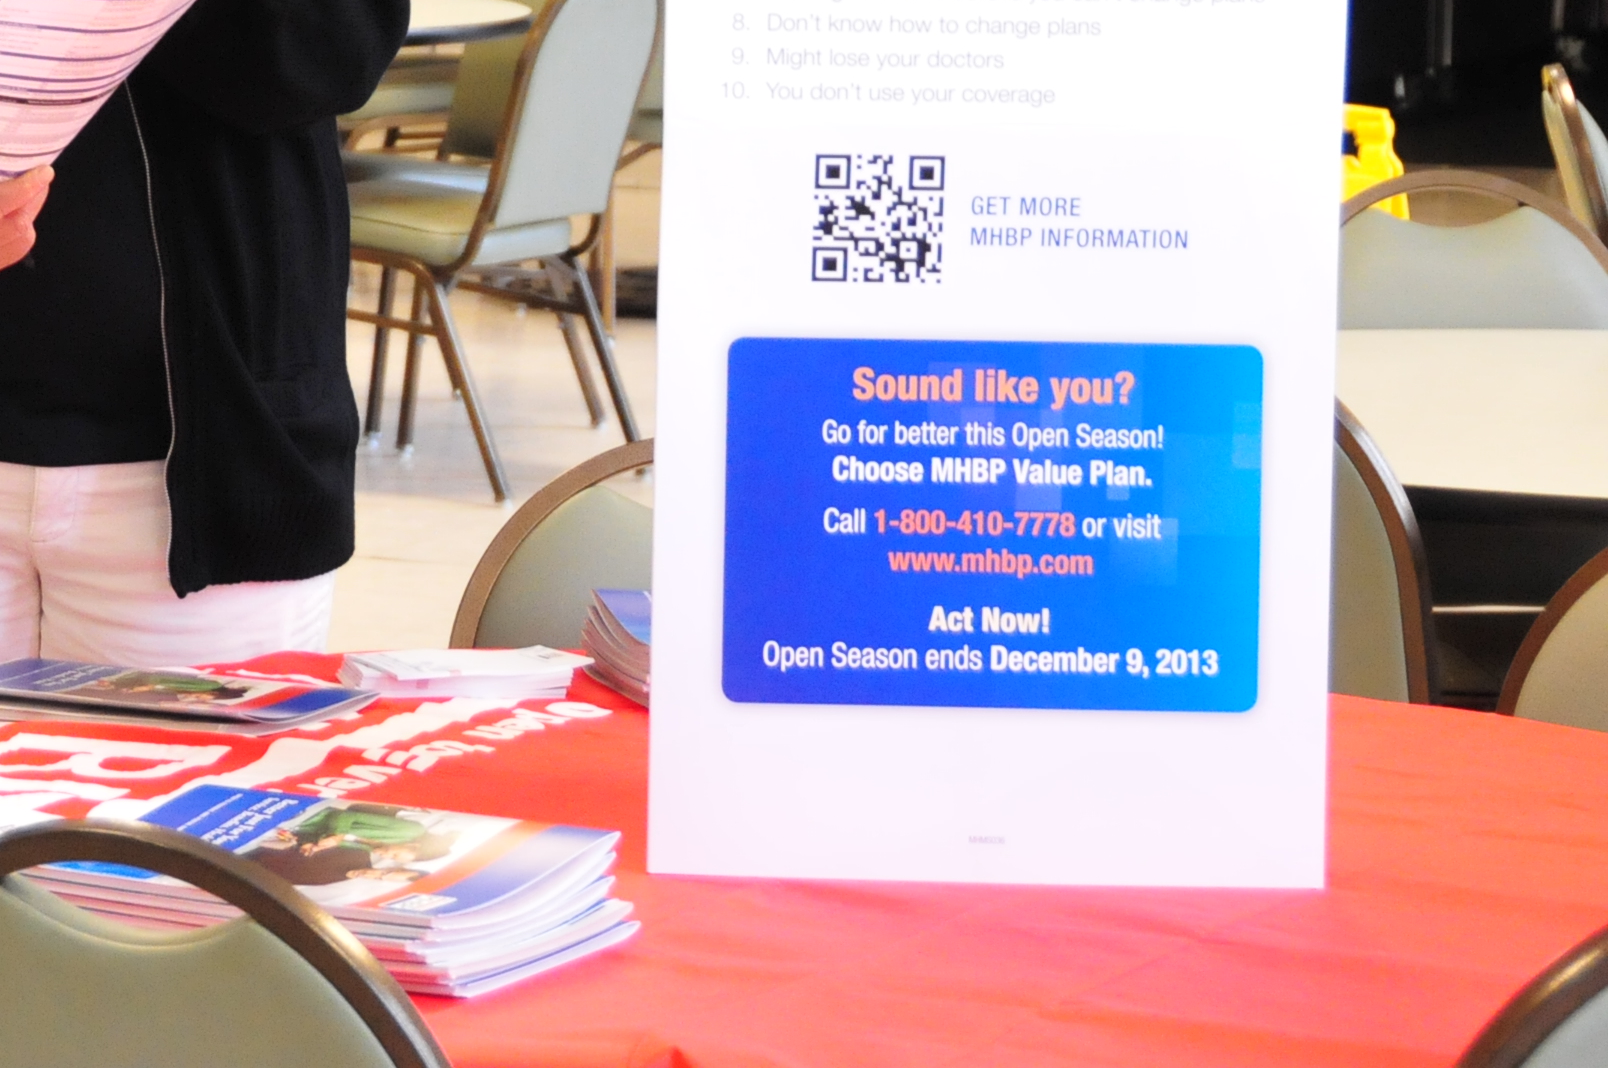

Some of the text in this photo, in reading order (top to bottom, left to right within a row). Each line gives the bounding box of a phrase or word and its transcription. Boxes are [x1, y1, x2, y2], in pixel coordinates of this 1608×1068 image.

[732, 13, 750, 31] 8.
[828, 15, 883, 33] know
[889, 15, 932, 33] how
[939, 17, 959, 34] to
[965, 16, 1041, 39] change
[1047, 18, 1101, 38] plans
[731, 47, 1004, 71] 9. Might lose your doctors
[722, 81, 749, 99] 10.
[766, 82, 803, 100] You
[869, 87, 905, 102] use
[911, 88, 955, 106] your
[962, 88, 1056, 108] coverage
[971, 196, 1080, 217] GET MORE
[970, 227, 1188, 249] MHBP INFORMATION
[853, 367, 1136, 410] Sound like you?
[822, 419, 1164, 451] Go for better this Open Season!
[832, 455, 1152, 486] Choose MHBP Value Plan.
[823, 507, 1161, 539] Call 1-800-410-7778 or visit
[888, 548, 1093, 579] www.mhbp.com
[929, 606, 1050, 634] Act Now!
[763, 641, 1219, 678] Open Season ends December 9, 2013
[462, 700, 614, 740] Open
